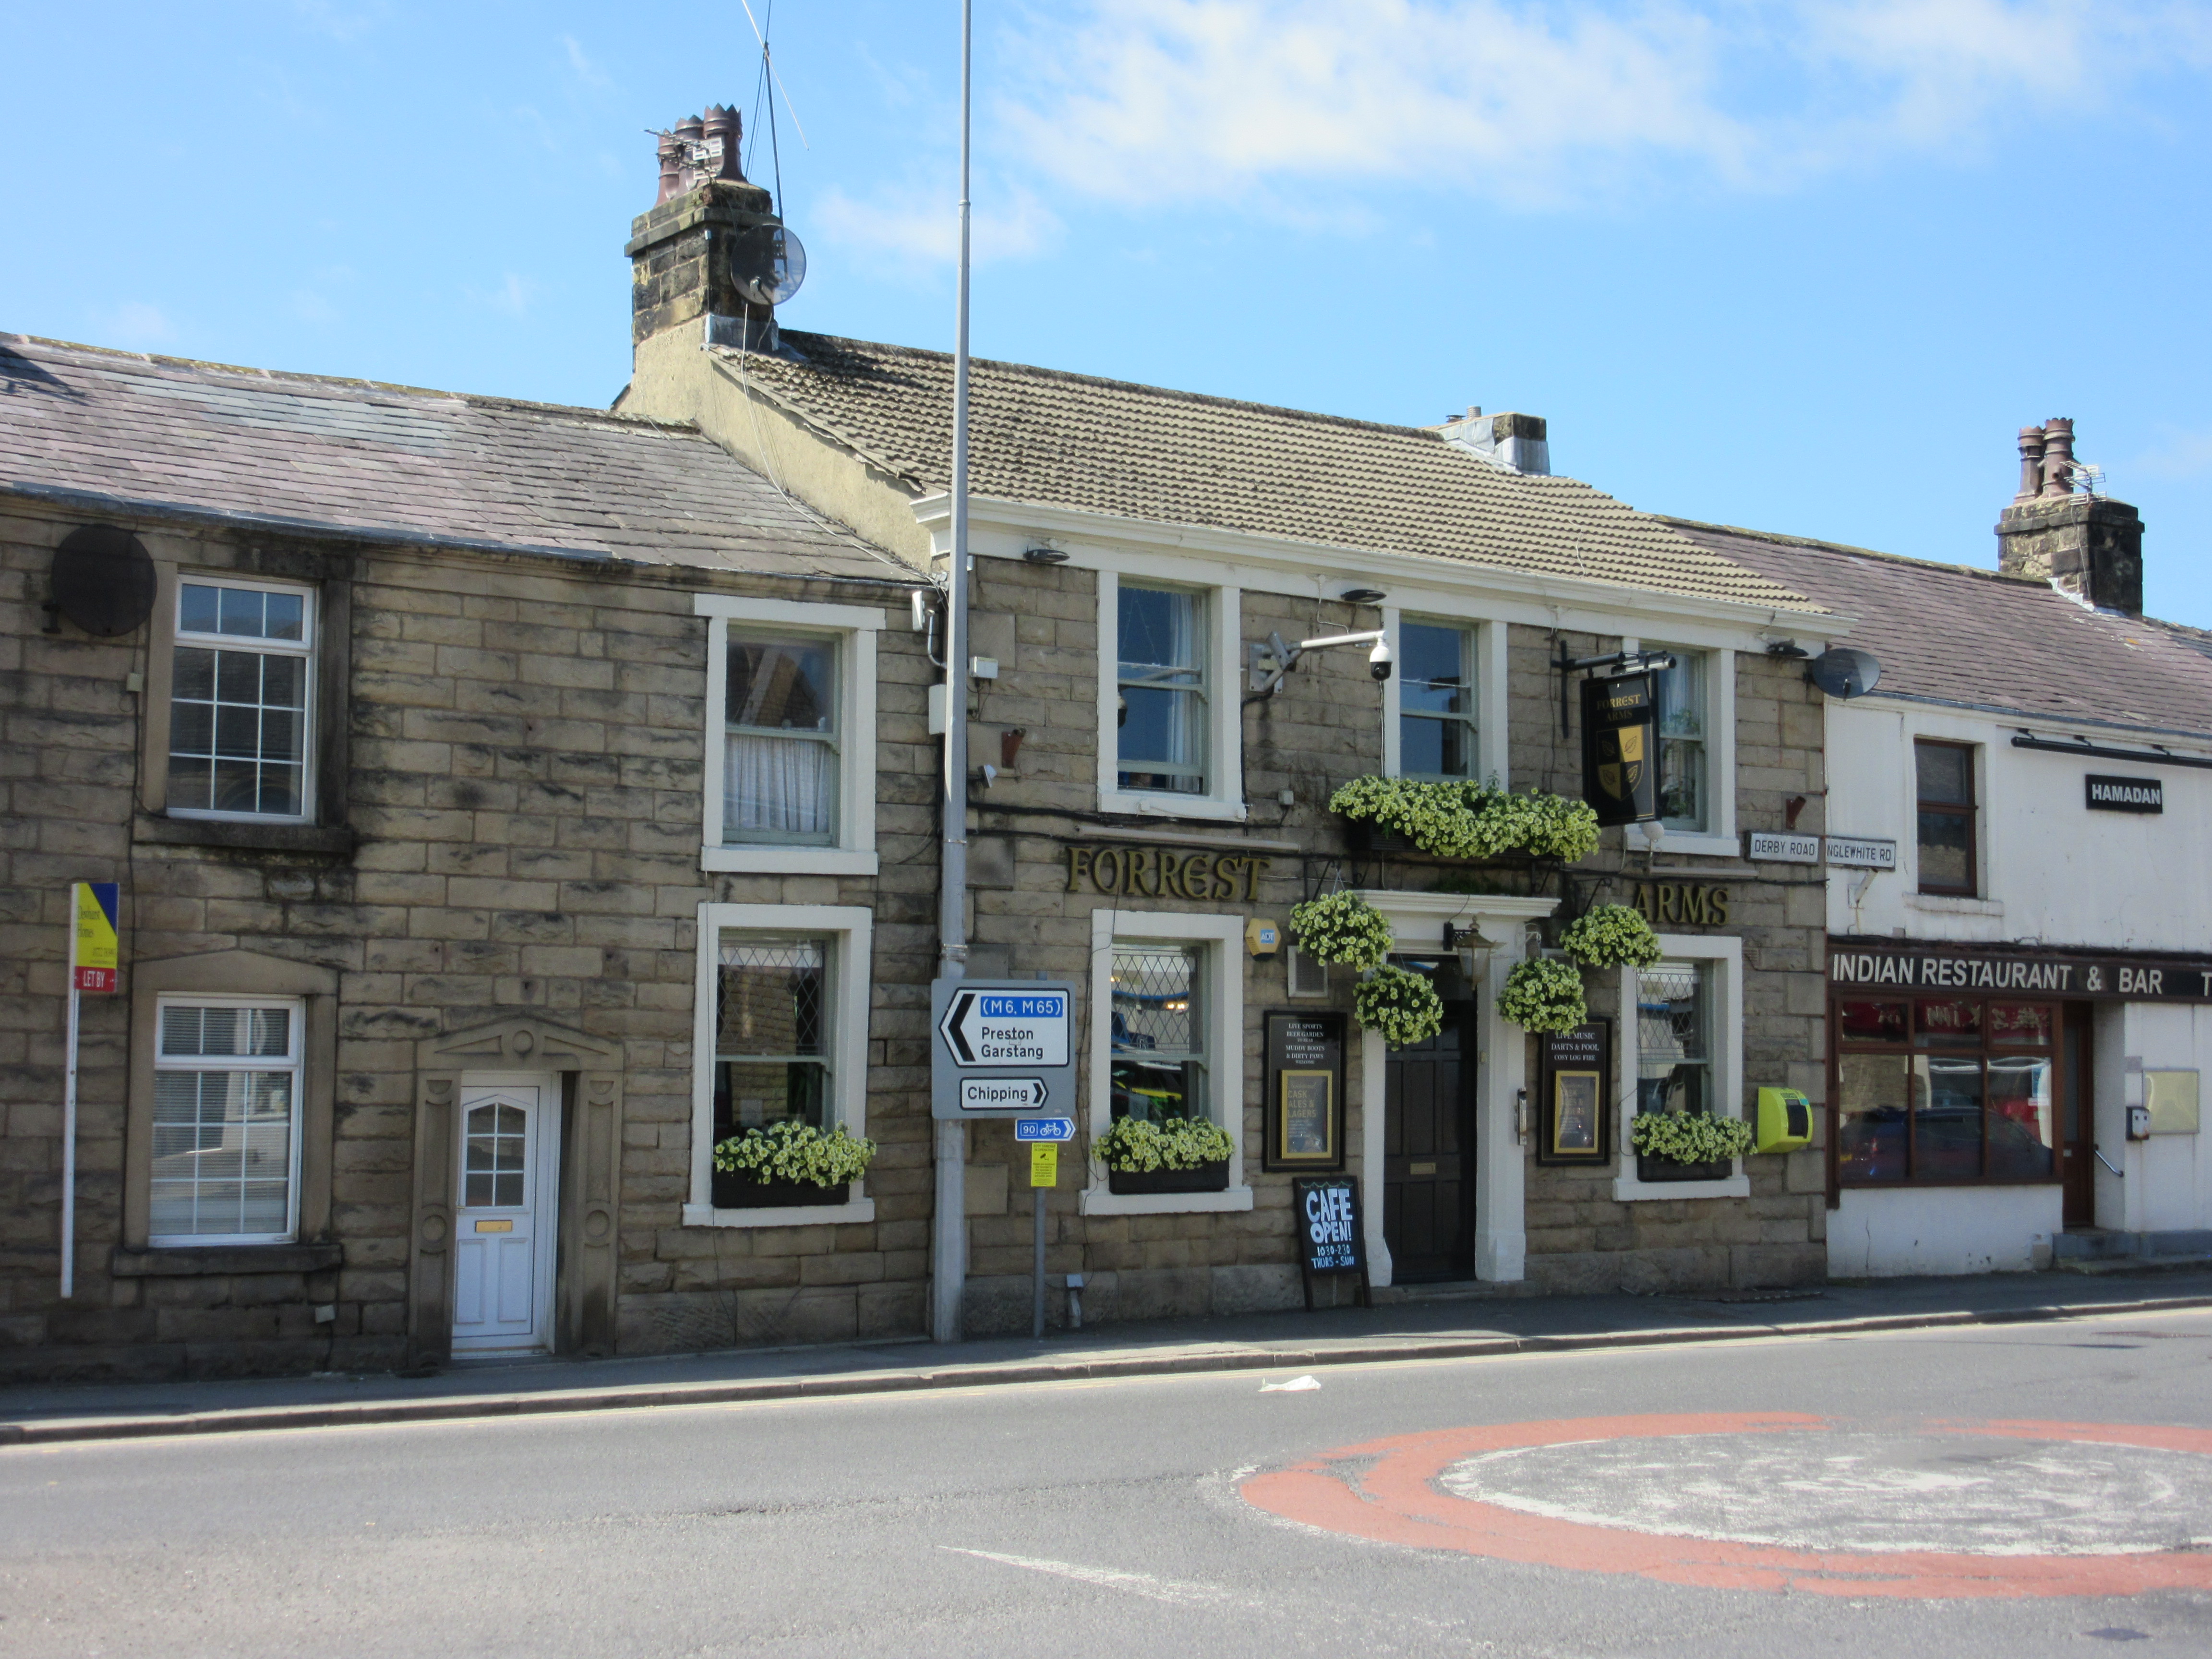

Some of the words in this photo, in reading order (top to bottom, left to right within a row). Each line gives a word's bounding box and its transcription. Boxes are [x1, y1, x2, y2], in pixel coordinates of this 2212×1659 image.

[1597, 694, 1641, 710] FORREST
[1606, 710, 1633, 721] ARMS
[2092, 784, 2160, 804] HAMADAN
[1755, 840, 1785, 854] DERBY
[1790, 842, 1815, 856] ROAD
[1827, 844, 1876, 860] NGLEWHITE
[1879, 848, 1891, 861] RD
[1067, 847, 1271, 901] FORREST
[1635, 885, 1729, 926] ARMS
[1262, 933, 1274, 941] ADT
[84, 971, 96, 987] LET
[96, 971, 105, 988] BY
[1833, 954, 1914, 985] INDIAN
[1921, 958, 2072, 991] RESTAURANT
[2086, 966, 2102, 992] &
[2118, 967, 2163, 995] BAR
[981, 1026, 1034, 1040] Preston
[981, 1044, 1044, 1059] Garstang
[1581, 1043, 1599, 1051] POOL
[967, 1086, 1028, 1102] Chipping
[1288, 1100, 1307, 1108] ALES
[1287, 1110, 1316, 1118] LAGERS
[1023, 1125, 1036, 1134] 90
[1306, 1188, 1353, 1223] CAFE
[1310, 1221, 1352, 1244] OPEN!
[1310, 1256, 1334, 1269] THURS
[1340, 1256, 1354, 1266] SUN
